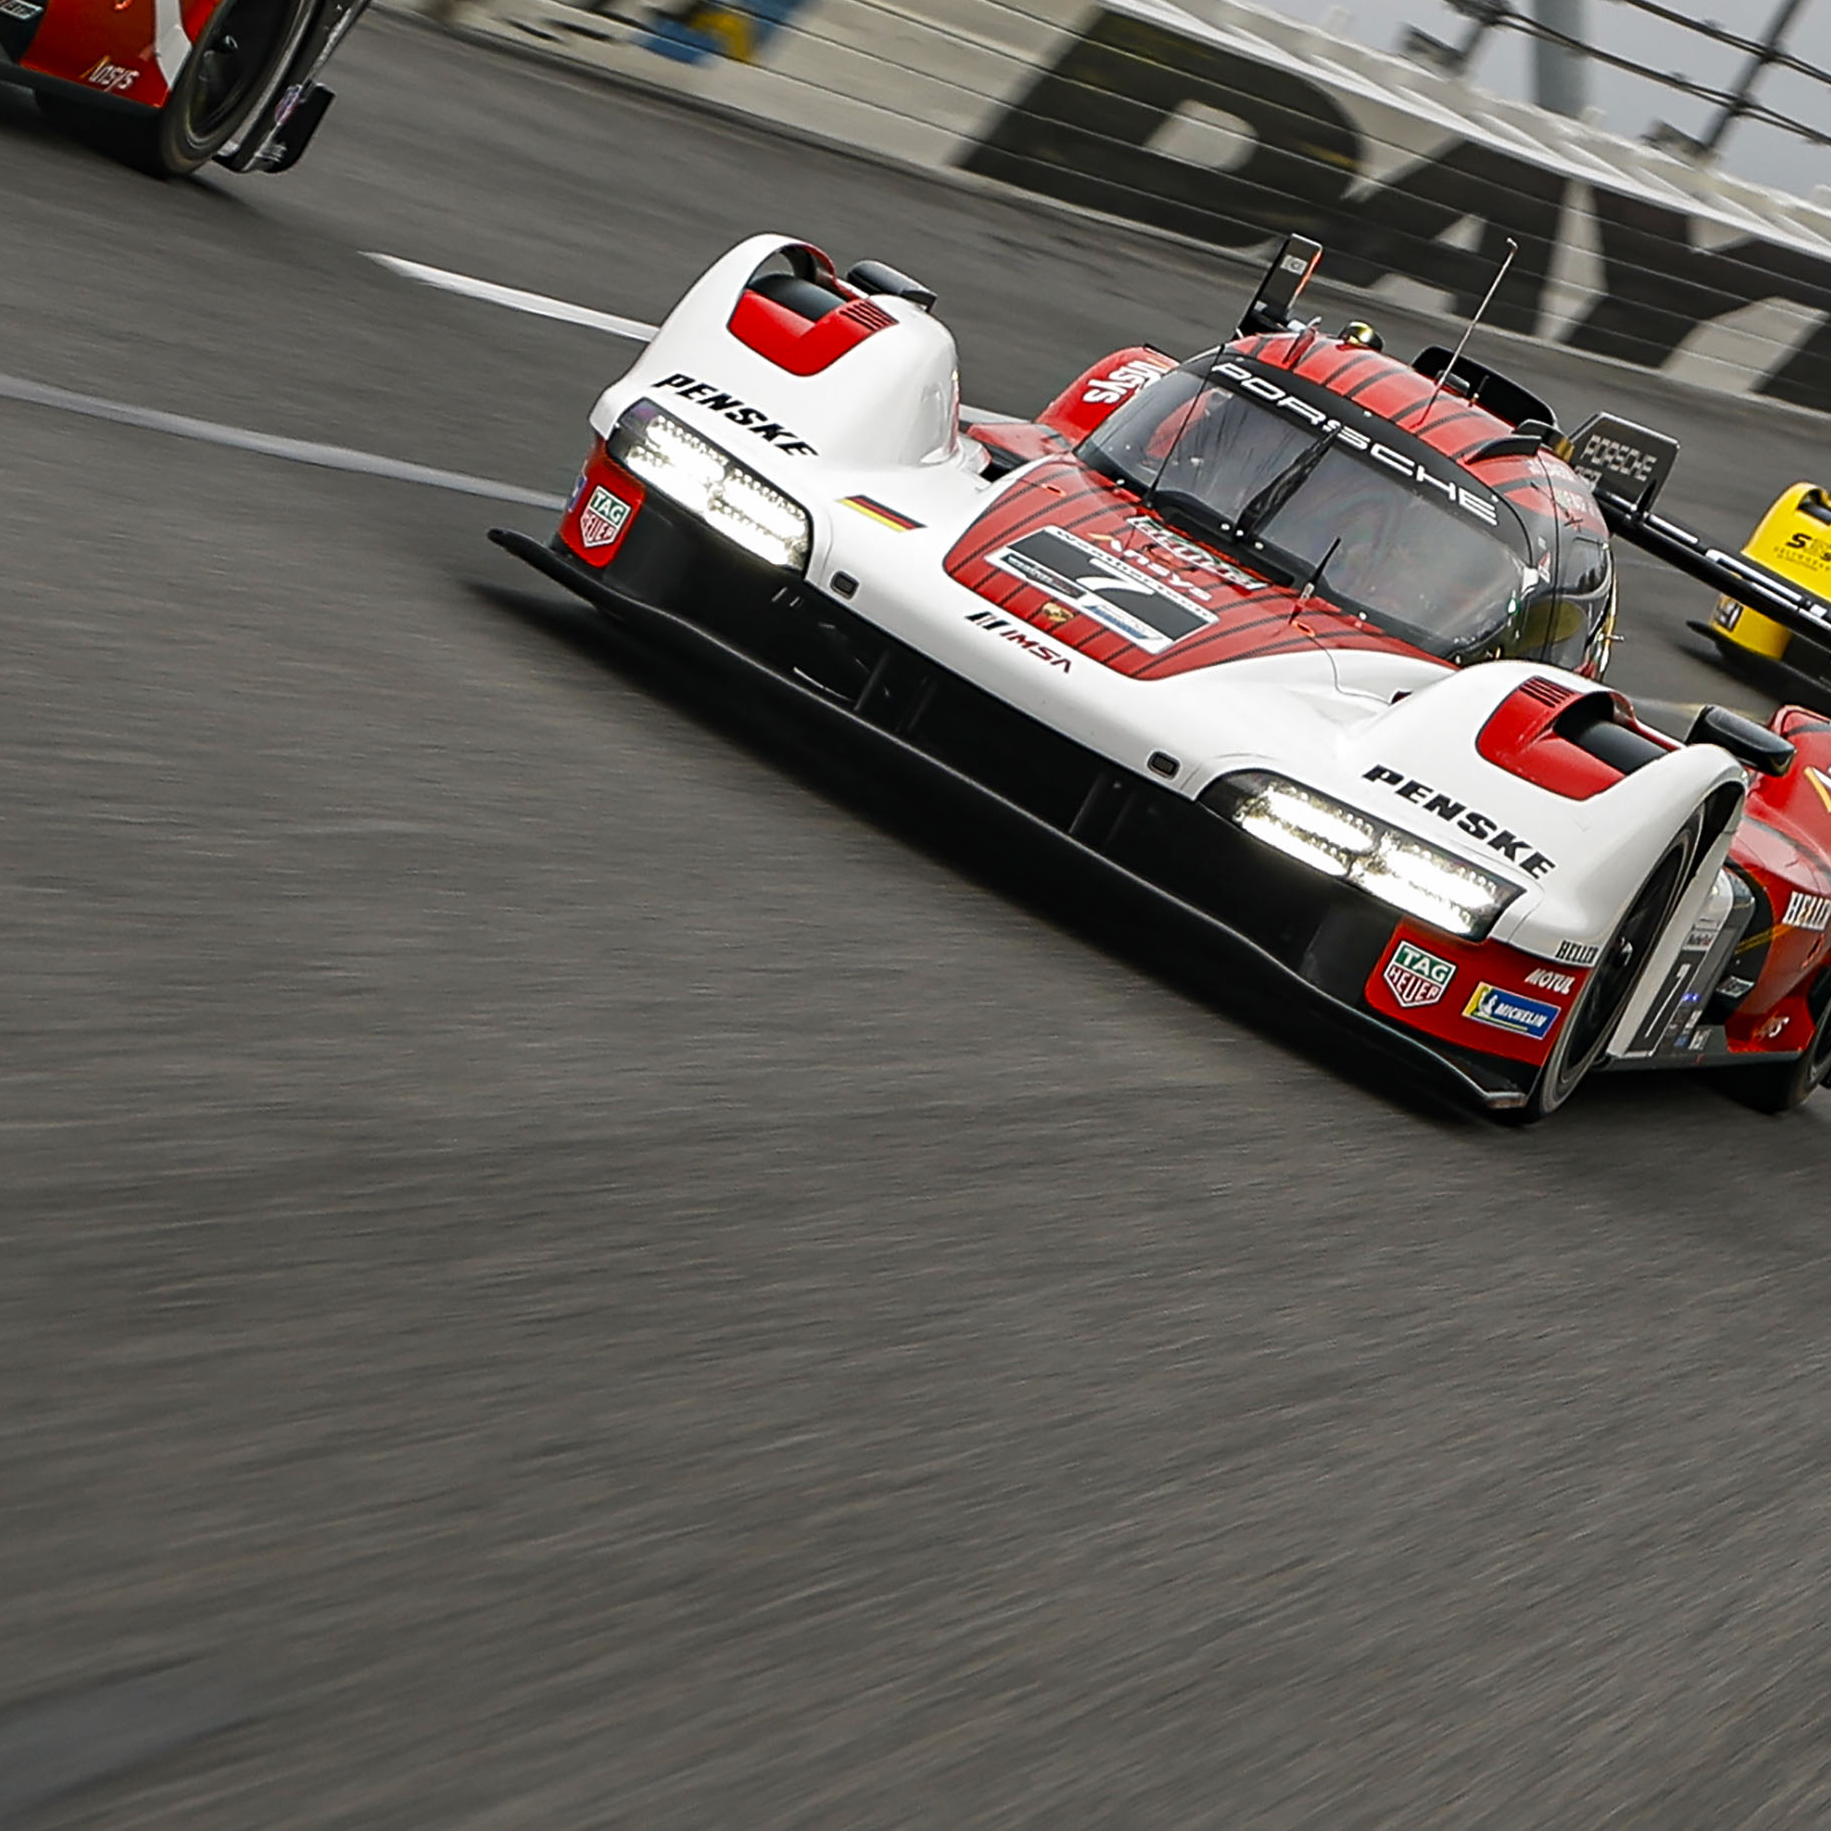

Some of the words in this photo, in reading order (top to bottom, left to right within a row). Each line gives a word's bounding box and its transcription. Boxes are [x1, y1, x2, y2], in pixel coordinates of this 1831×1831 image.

[648, 372, 819, 459] PENSKE
[1211, 362, 1499, 527] PORSCHE
[1580, 434, 1658, 483] PORSCHE
[592, 491, 626, 523] TAG
[1075, 557, 1156, 596] 7
[1087, 531, 1213, 602] Ansys
[999, 630, 1072, 674] IMSA
[1361, 763, 1558, 880] PENSKE
[1387, 964, 1442, 1004] HEUER
[1399, 946, 1450, 983] TAG
[1524, 967, 1576, 995] MOTUL
[1493, 1002, 1549, 1029] MICHELIN
[1644, 963, 1693, 1039] 7
